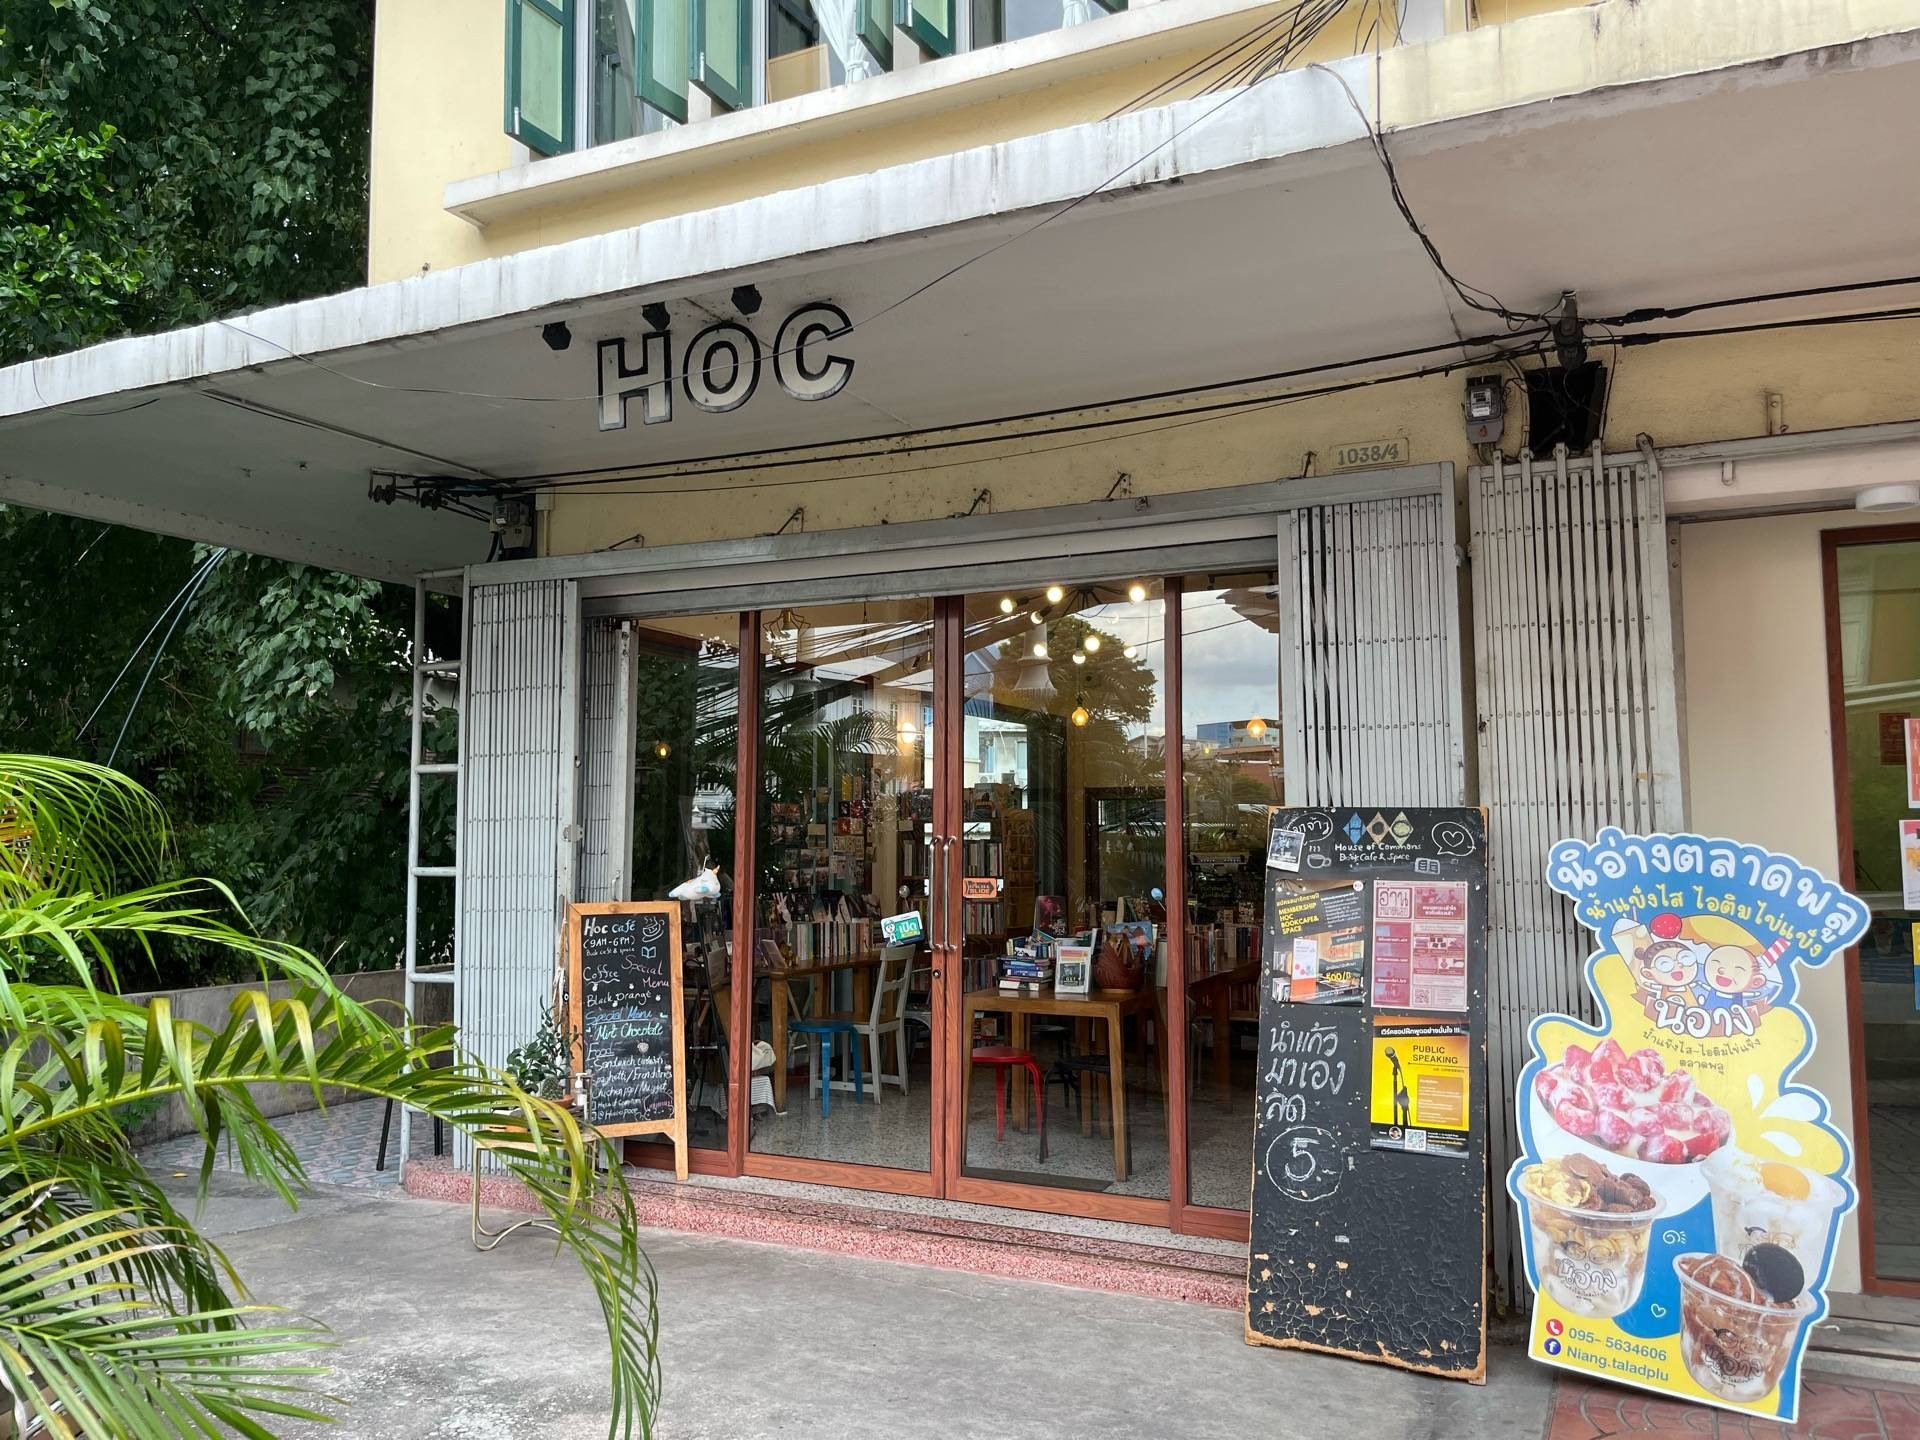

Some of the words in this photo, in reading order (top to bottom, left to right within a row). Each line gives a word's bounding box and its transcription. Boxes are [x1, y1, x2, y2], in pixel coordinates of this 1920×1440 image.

[597, 302, 855, 432] HOC
[1338, 443, 1399, 465] 1038/4
[1334, 842, 1364, 851] House
[1366, 842, 1376, 851] of
[1378, 842, 1422, 852] Commons
[1387, 853, 1411, 863] Space
[1586, 884, 1684, 920] น้ำแข็งไส
[584, 917, 608, 936] Hoc
[1280, 913, 1294, 922] HOC
[1282, 925, 1302, 934] SPACE
[583, 964, 619, 981] Coffee
[621, 954, 663, 974] Special
[642, 976, 670, 988] Menu
[585, 1007, 622, 1025] Special
[620, 1022, 664, 1037] Chocolate
[587, 1041, 613, 1059] Food
[1412, 1044, 1445, 1054] PUBLIC
[1412, 1054, 1458, 1064] SPEAKING
[1265, 1058, 1346, 1095] มาเอง
[1605, 1336, 1667, 1361] 5634606
[1566, 1345, 1670, 1382] Niang.taladplu
